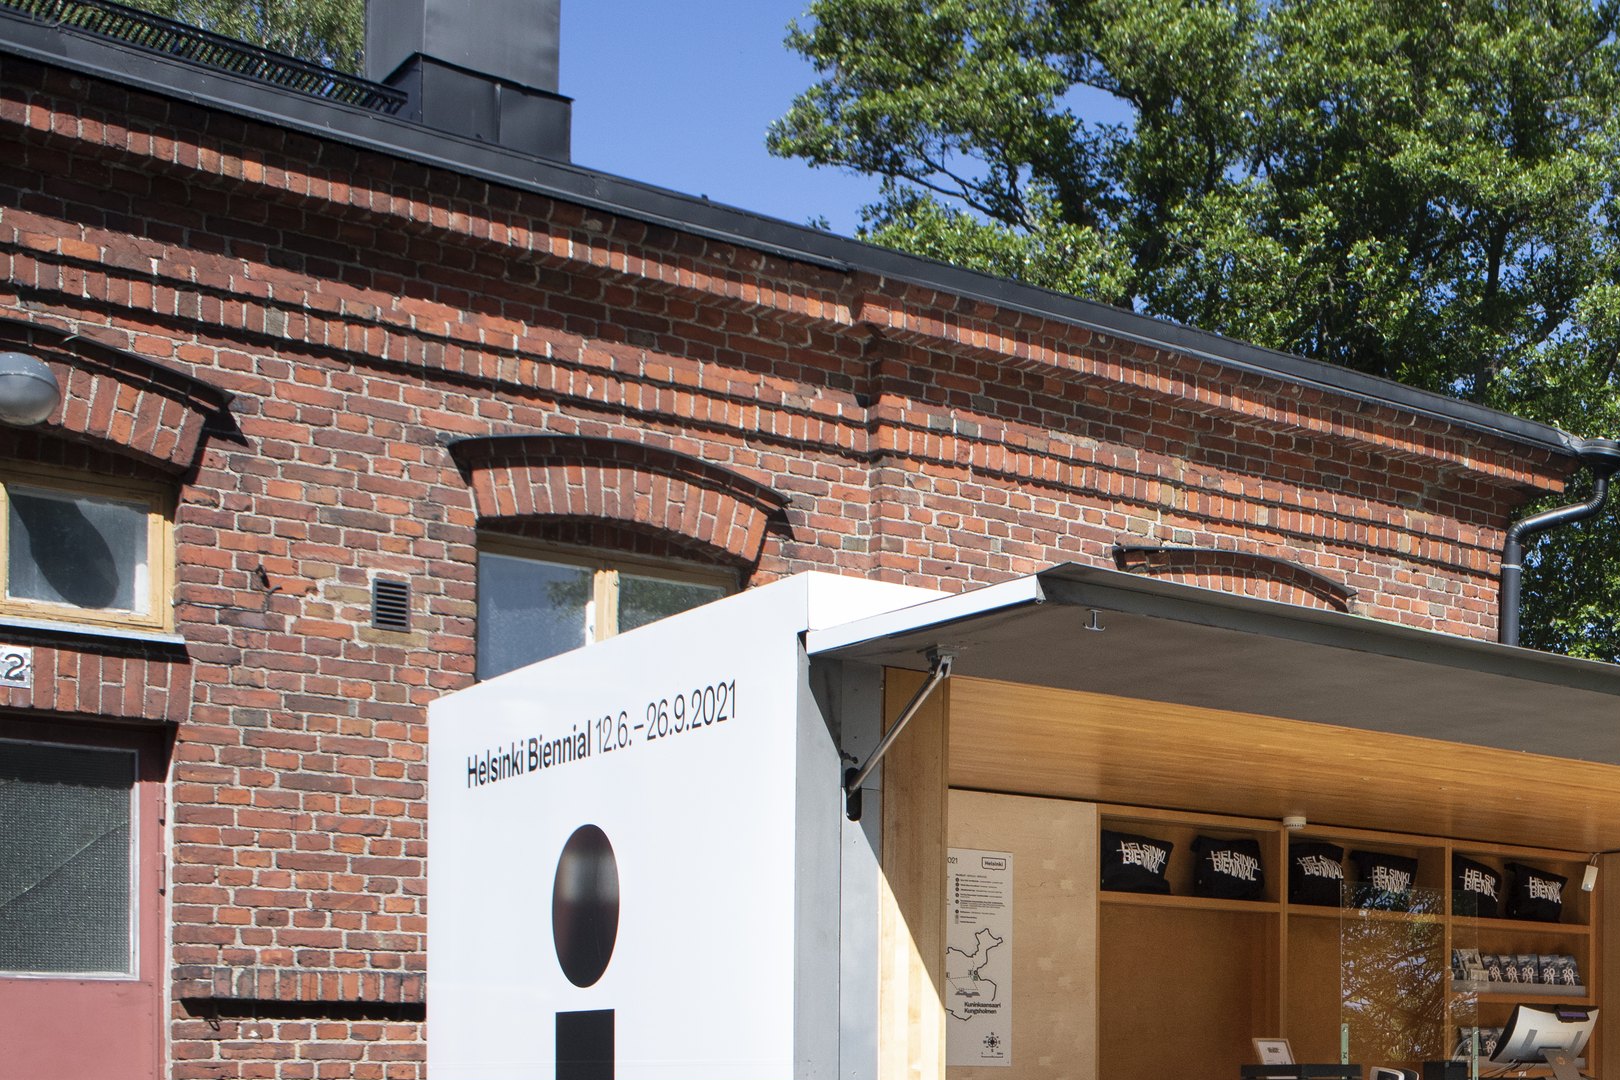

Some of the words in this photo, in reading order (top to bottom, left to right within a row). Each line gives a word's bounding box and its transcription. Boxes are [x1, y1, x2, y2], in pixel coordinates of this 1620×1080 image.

[467, 740, 524, 788] Helsinki
[528, 719, 591, 772] Biennial
[1372, 866, 1411, 883] HELSINKI
